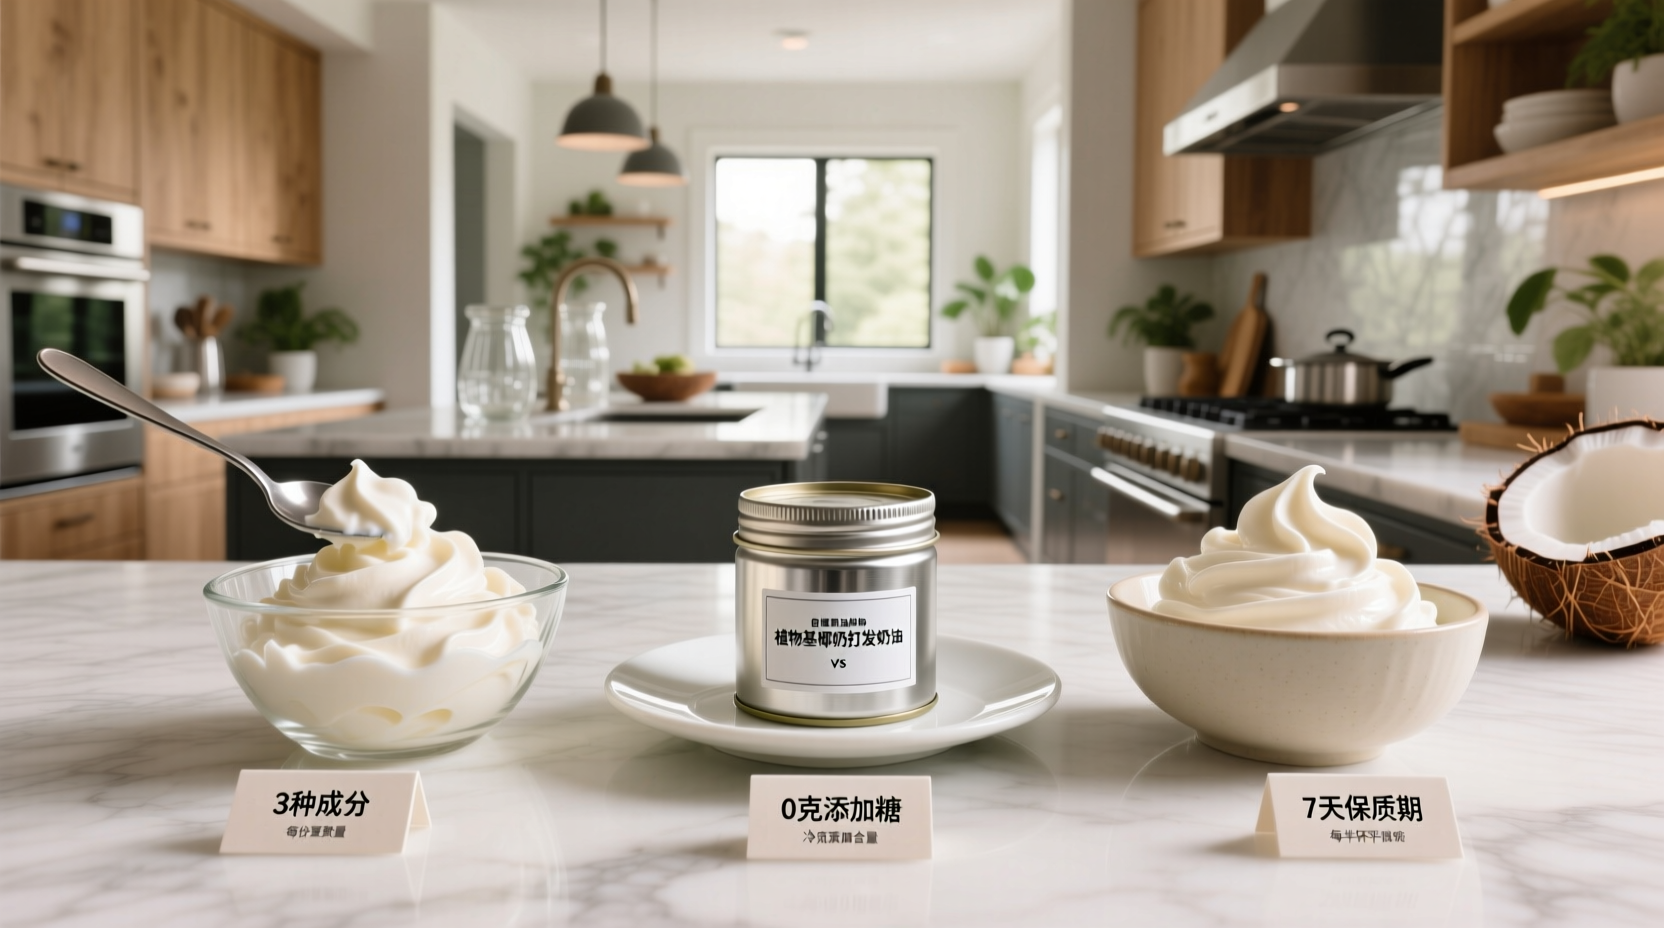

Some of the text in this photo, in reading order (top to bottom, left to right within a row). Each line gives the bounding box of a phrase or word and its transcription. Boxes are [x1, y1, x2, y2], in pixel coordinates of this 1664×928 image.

[272, 789, 370, 817] 3种成分
[781, 794, 903, 823] 0克添加糖
[1302, 794, 1423, 822] 7天保质期
